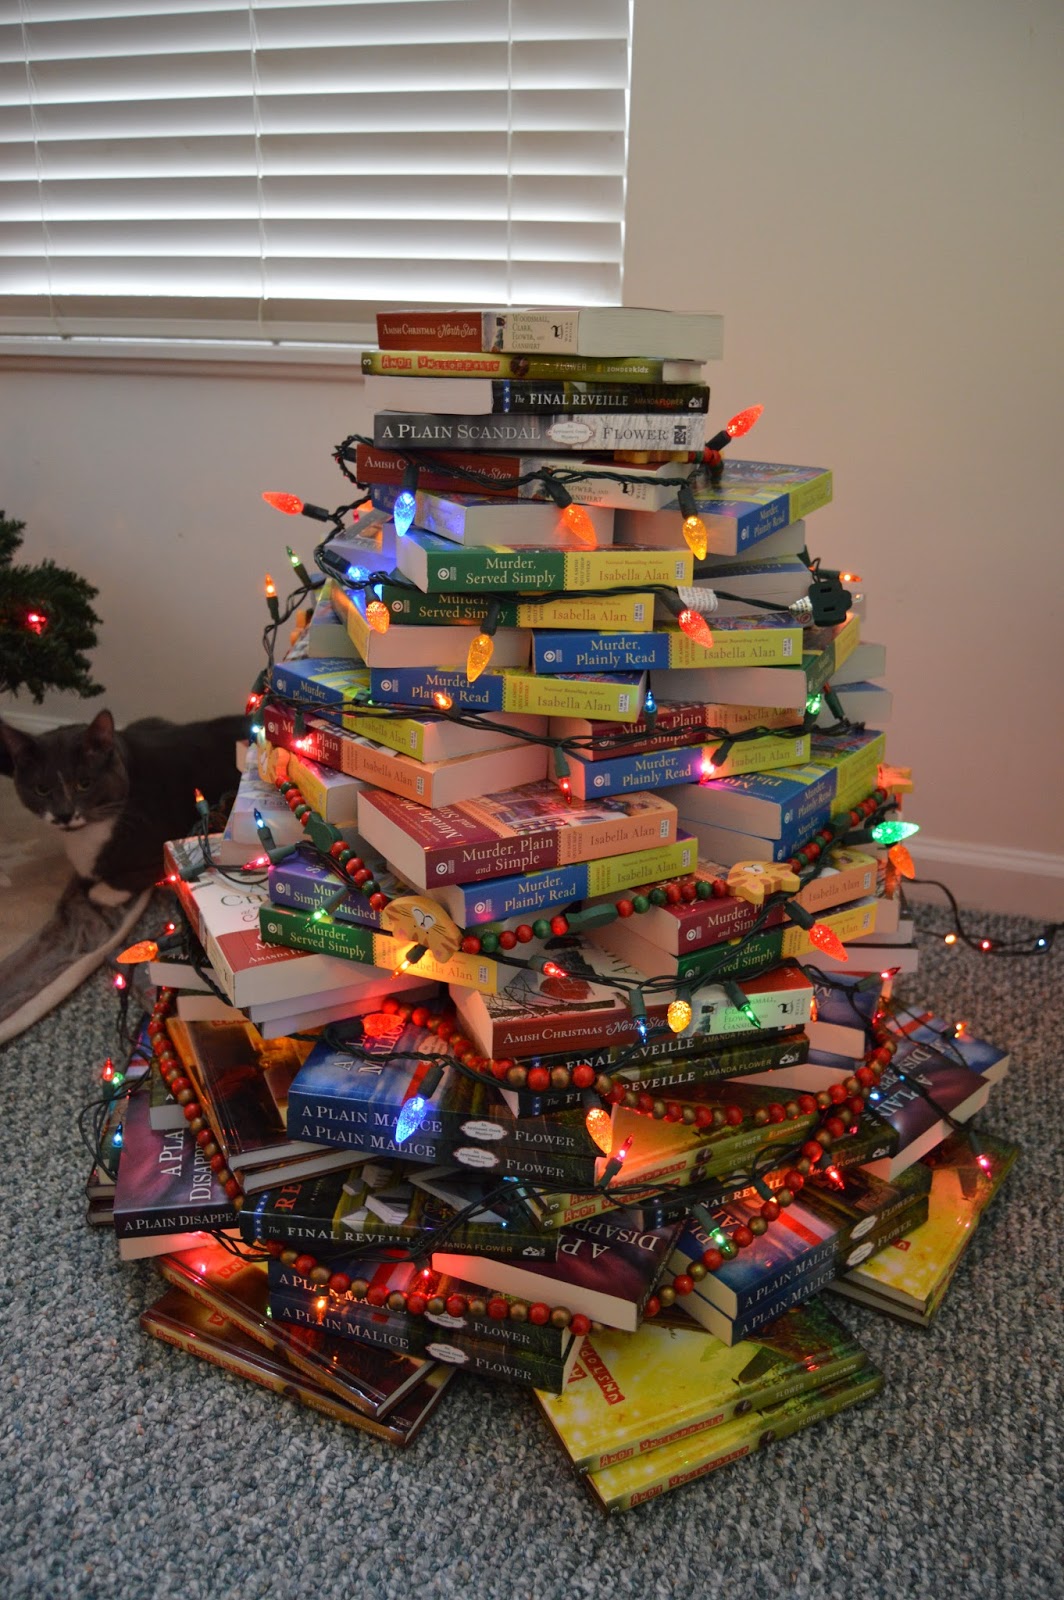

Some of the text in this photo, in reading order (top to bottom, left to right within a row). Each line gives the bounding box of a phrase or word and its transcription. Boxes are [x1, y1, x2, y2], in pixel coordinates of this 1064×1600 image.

[402, 324, 436, 336] CHRISTMAS
[460, 324, 478, 336] Star
[514, 394, 628, 406] The FINAL REVEILLE
[382, 424, 540, 440] A PLAIN SCANDAL
[603, 427, 668, 440] FLOWER
[365, 456, 395, 470] AMISH
[486, 557, 536, 570] Murder,
[466, 570, 556, 588] Served Simply
[600, 568, 640, 581] Isabella
[644, 569, 670, 580] Alan
[419, 606, 460, 618] Served
[552, 608, 627, 622] Isabella Alan
[591, 638, 640, 651] Murder,
[703, 645, 776, 660] Isabella Alan
[576, 650, 656, 668] Plainly Read
[426, 674, 475, 689] Murder,
[301, 681, 328, 700] Murder,
[459, 690, 489, 704] Read
[538, 696, 612, 712] Isabella Alan
[674, 714, 702, 728] Plain
[735, 707, 799, 724] Isabella Alan
[317, 733, 339, 751] Plain
[390, 729, 407, 746] Alan
[635, 757, 678, 772] Murder,
[732, 750, 791, 768] Isabella Alan
[363, 758, 412, 786] Isabella Alan
[622, 768, 692, 788] Plainly Read
[421, 809, 463, 840] Murder,
[590, 826, 655, 846] Isabella Alan
[462, 836, 554, 863] Murder, Plain
[476, 852, 540, 875] and Simple
[618, 862, 677, 882] Isabella Alan
[518, 876, 564, 896] Murder,
[809, 878, 860, 902] Isabella Alan
[504, 884, 576, 912] Plainly Read
[707, 908, 751, 928] Murder,
[306, 924, 349, 942] Murder,
[718, 929, 730, 938] and
[840, 924, 858, 935] Alan
[290, 932, 325, 950] Served
[328, 938, 366, 960] Simply
[248, 952, 289, 964] AMANDA
[742, 950, 775, 968] Simply
[448, 966, 473, 981] Alan
[503, 1026, 603, 1044] AMISH CHRISTMAS
[703, 1034, 737, 1044] AMANDA
[703, 1059, 772, 1077] AMANDA FLOWER
[302, 1106, 368, 1124] A PLAIN
[302, 1124, 436, 1158] A PLAIN MALICE
[515, 1130, 575, 1146] FLOWER
[734, 1135, 762, 1149] FLOWER
[160, 1164, 182, 1177] A
[506, 1159, 564, 1178] FLOWER
[550, 1203, 560, 1211] 3
[881, 1193, 915, 1220] FLOWER
[124, 1218, 176, 1231] A PLAIN
[269, 1226, 340, 1240] The FINAL
[878, 1220, 912, 1248] FLOWER
[474, 1242, 513, 1253] FLOWER
[280, 1274, 288, 1284] A
[745, 1241, 840, 1308] A PLAIN MALICE
[740, 1268, 836, 1336] A PLAIN MALICE
[282, 1308, 292, 1318] A
[347, 1323, 409, 1350] MALICE
[474, 1322, 530, 1345] FLOWER
[476, 1357, 532, 1380] FLOWER
[776, 1383, 804, 1399] FLOWER
